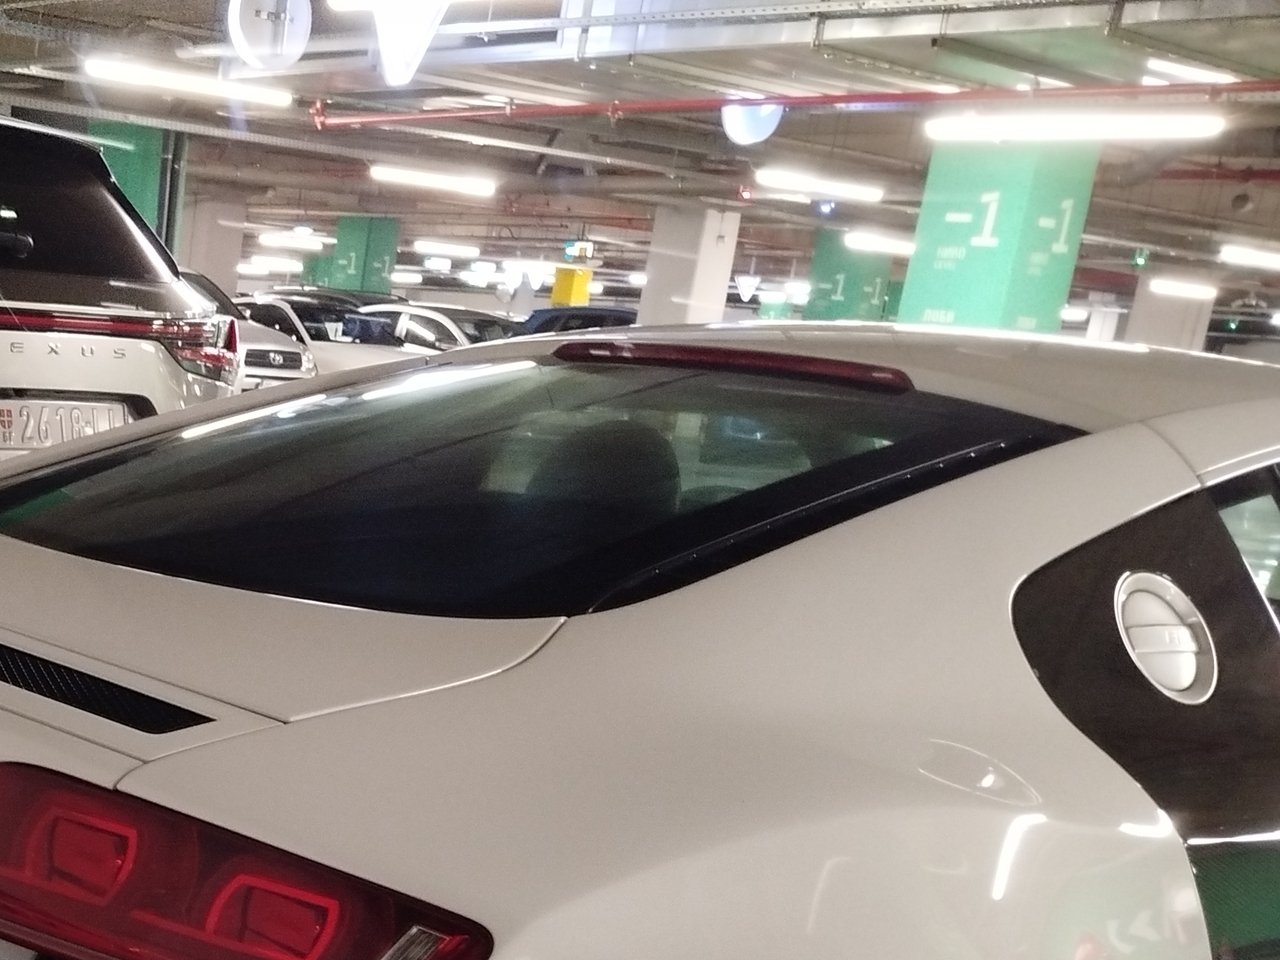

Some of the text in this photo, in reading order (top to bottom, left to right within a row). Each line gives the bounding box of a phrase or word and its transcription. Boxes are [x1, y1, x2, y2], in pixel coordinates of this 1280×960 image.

[945, 191, 1000, 247] -1
[1038, 199, 1074, 253] -1
[338, 252, 357, 274] -1
[818, 273, 845, 301] -1
[863, 277, 882, 304] -1
